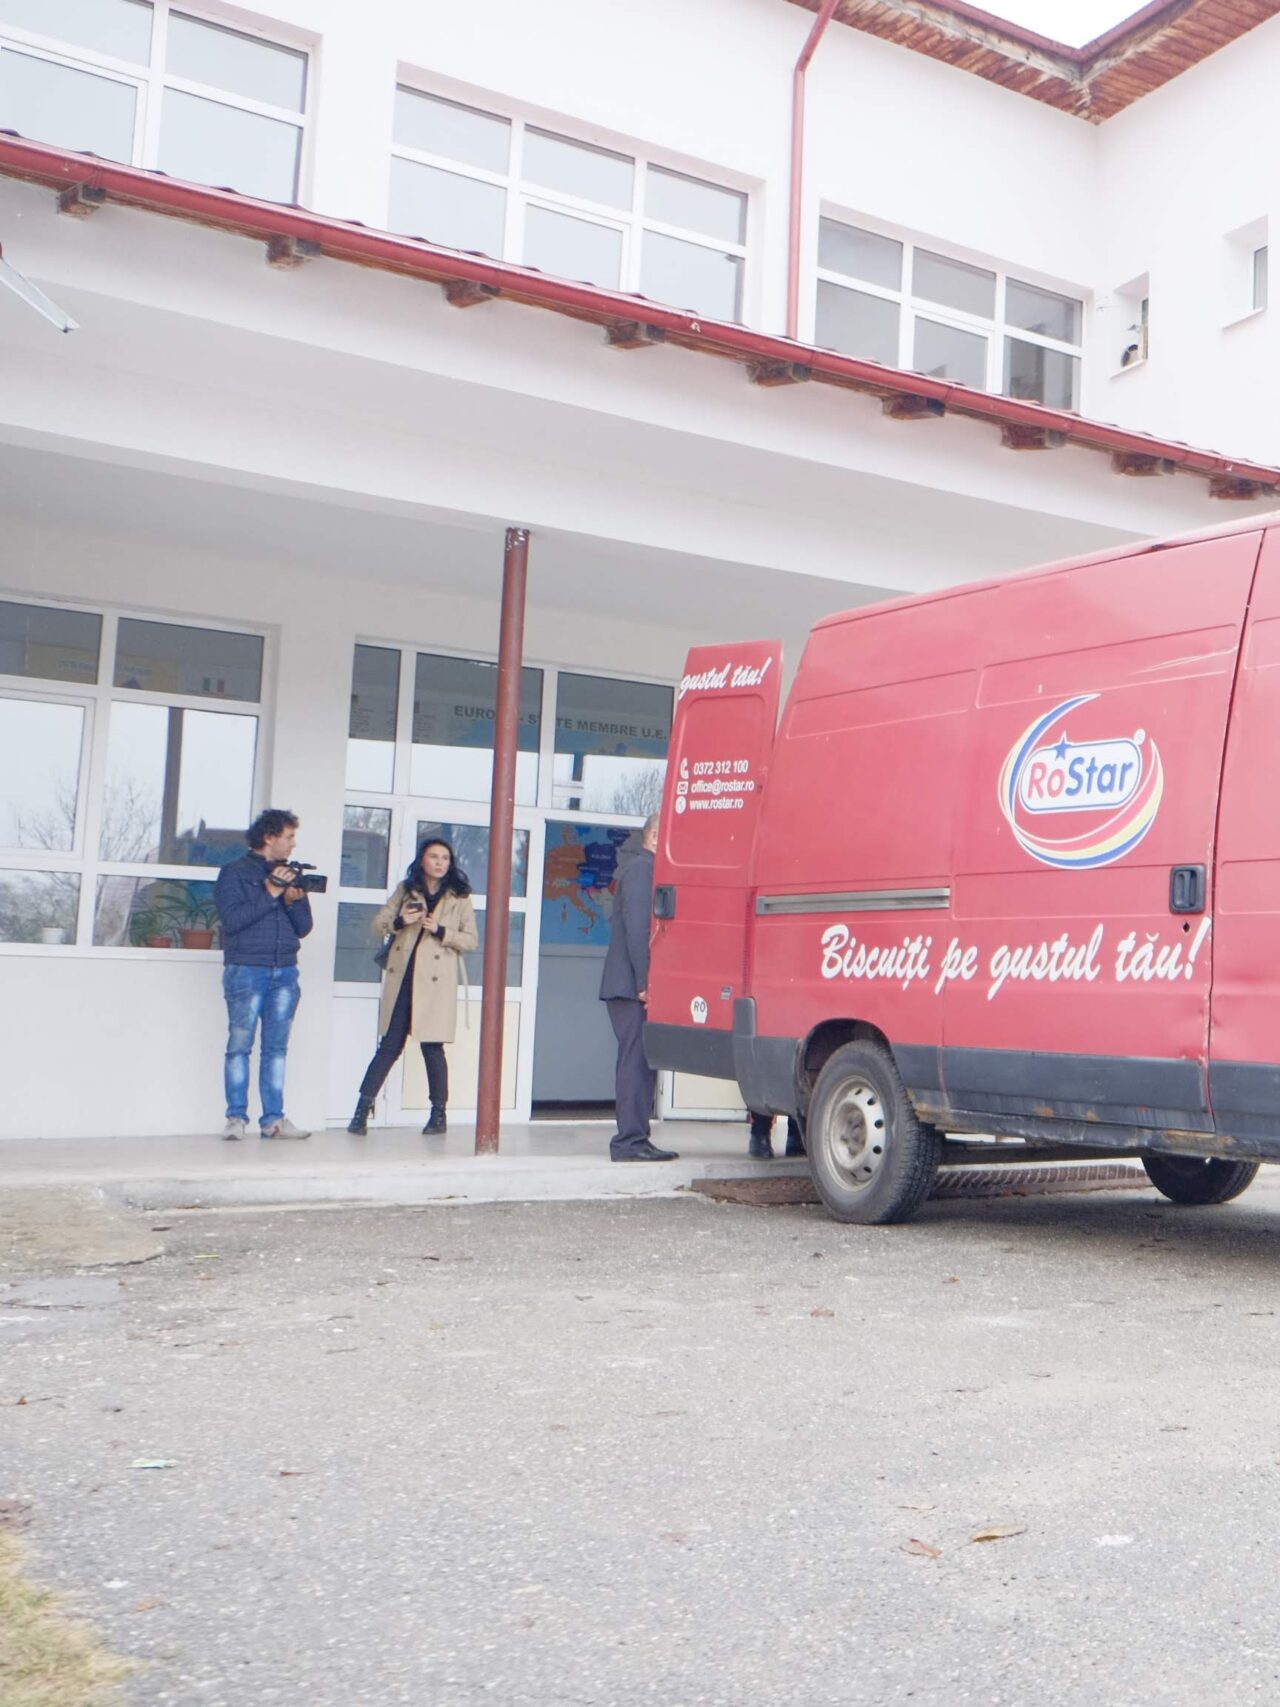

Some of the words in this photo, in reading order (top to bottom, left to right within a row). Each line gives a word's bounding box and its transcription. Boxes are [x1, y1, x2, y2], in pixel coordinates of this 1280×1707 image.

[679, 663, 731, 700] gustul
[454, 705, 496, 720] EURO
[528, 714, 573, 729] STE
[577, 719, 637, 737] MEMBRE
[641, 728, 667, 740] U.E.
[693, 763, 713, 775] 0372
[715, 761, 730, 774] 312
[733, 760, 749, 773] 100
[1027, 756, 1134, 799] RoStar
[691, 779, 755, 796] office@rostar.ro
[689, 797, 743, 810] www.rostar.ro
[934, 937, 978, 995] pe
[987, 923, 1104, 1000] gustul
[1115, 916, 1212, 982] tău!
[693, 1000, 706, 1013] RO
